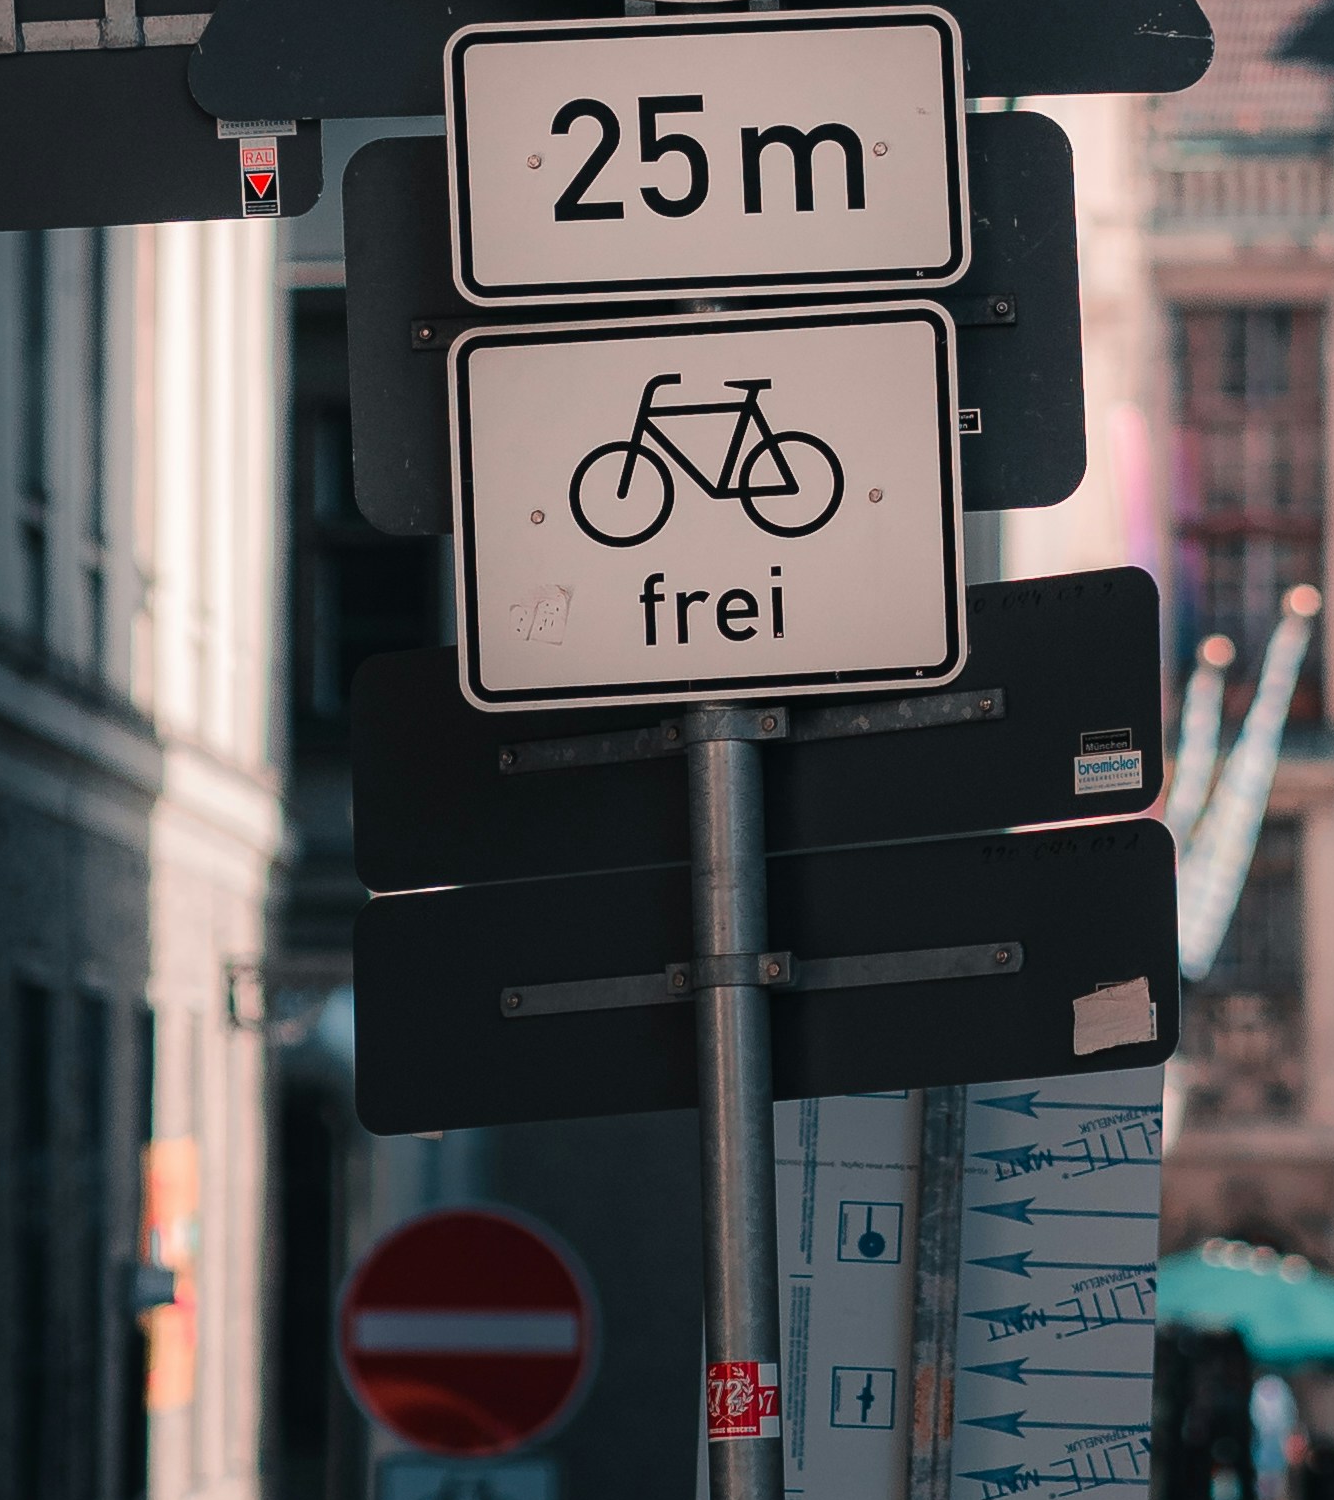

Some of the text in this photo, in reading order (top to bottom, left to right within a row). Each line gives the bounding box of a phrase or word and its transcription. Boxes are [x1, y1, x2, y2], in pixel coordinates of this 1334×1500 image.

[245, 151, 273, 164] RAL
[551, 94, 866, 222] 25 m
[639, 565, 785, 646] frei
[1085, 740, 1128, 752] München
[1078, 754, 1140, 776] bremicker
[995, 1148, 1054, 1182] MATT
[987, 1308, 1047, 1342] MATT
